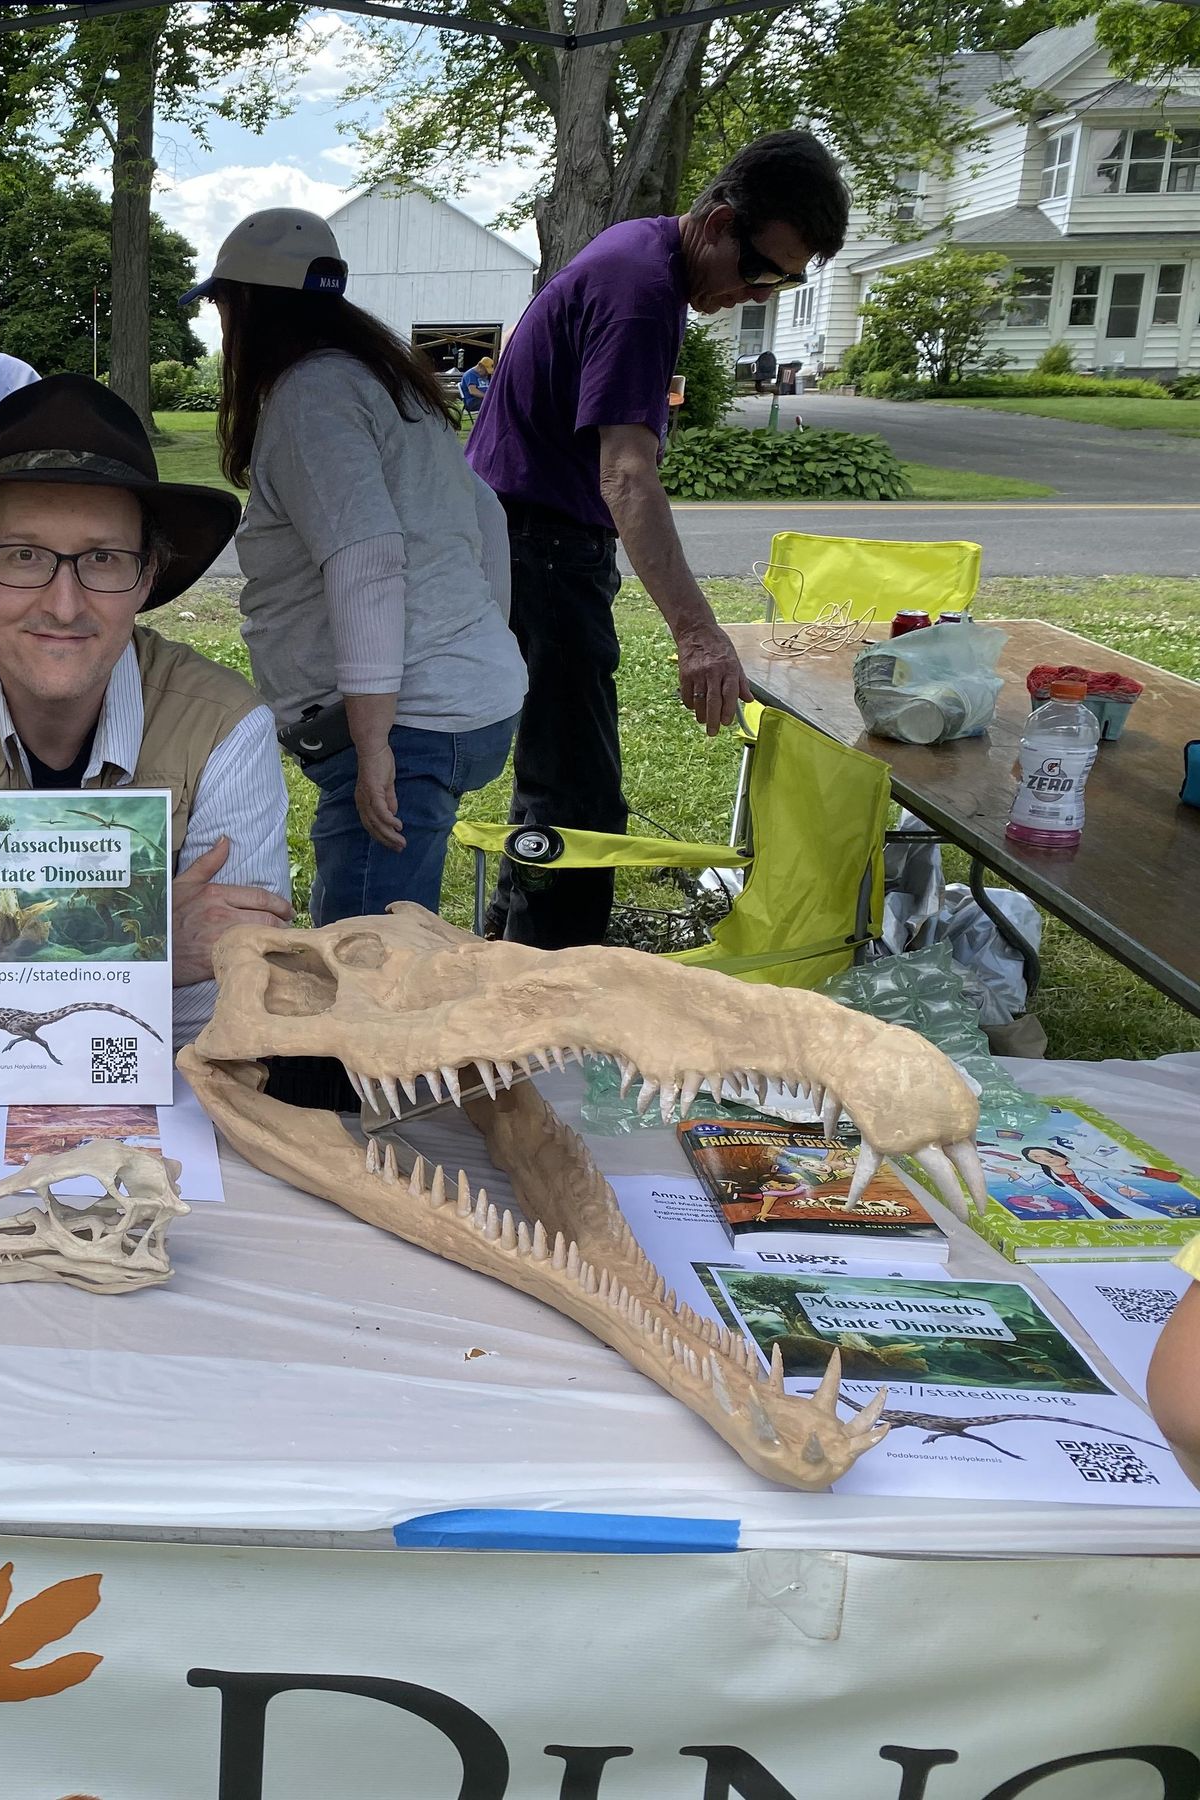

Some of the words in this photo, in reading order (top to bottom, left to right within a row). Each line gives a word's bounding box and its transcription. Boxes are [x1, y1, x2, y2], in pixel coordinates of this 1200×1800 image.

[319, 277, 340, 289] NASA
[1026, 774, 1074, 793] ZERO
[40, 865, 127, 884] Dinosaur
[699, 1136, 791, 1147] FRAUDULENT
[794, 1138, 848, 1149] FOSSIL
[651, 1191, 686, 1200] Anna
[803, 1295, 986, 1317] Massachusetts
[816, 1315, 883, 1330] State
[885, 1318, 1005, 1338] Dinosaur
[886, 1451, 949, 1461] Podokosaurus
[950, 1455, 1003, 1464] Holyokensis
